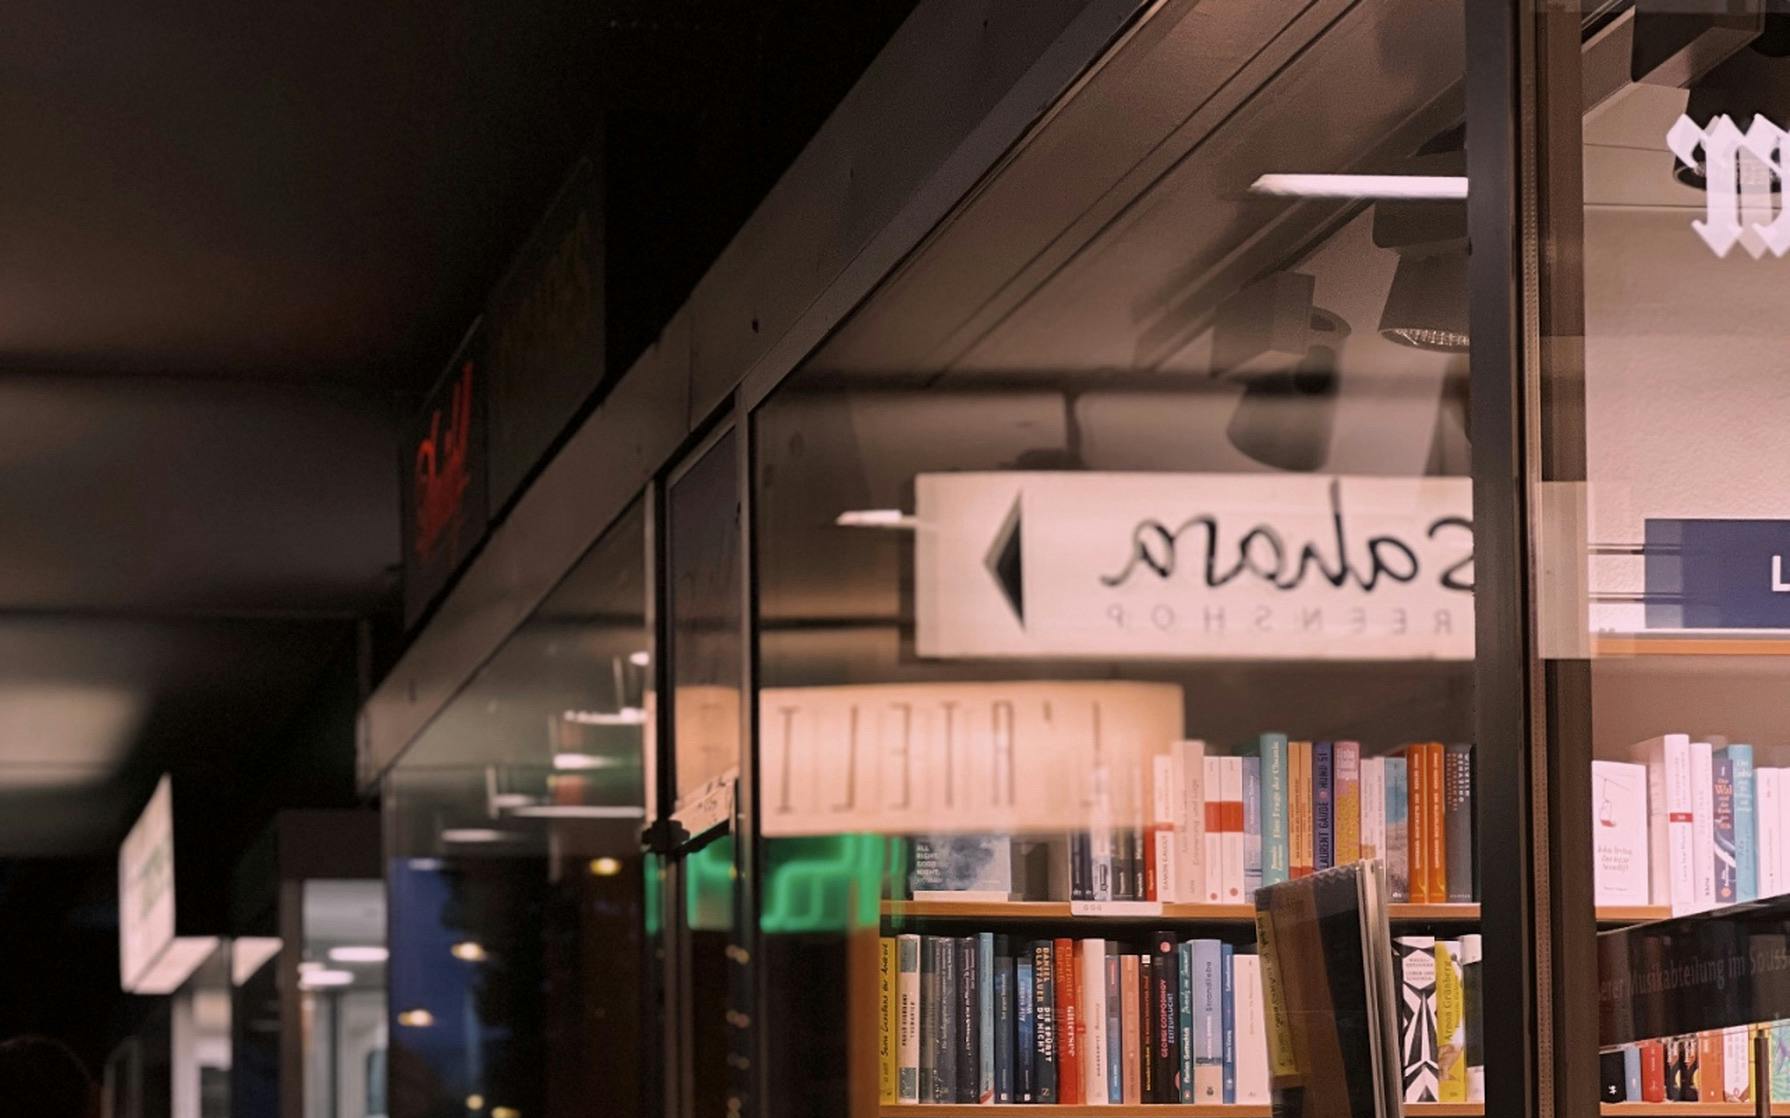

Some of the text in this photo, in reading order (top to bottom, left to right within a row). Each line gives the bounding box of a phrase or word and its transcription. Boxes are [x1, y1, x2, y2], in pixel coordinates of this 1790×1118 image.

[1271, 775, 1280, 790] der
[1318, 832, 1329, 867] LAURENT
[1443, 960, 1452, 1009] Grünberg
[1631, 956, 1725, 994] Musikabteilung
[1037, 1007, 1044, 1019] DU
[1159, 978, 1168, 1058] GEORGI GOSPODINOV
[1045, 1026, 1053, 1062] SPÜRST
